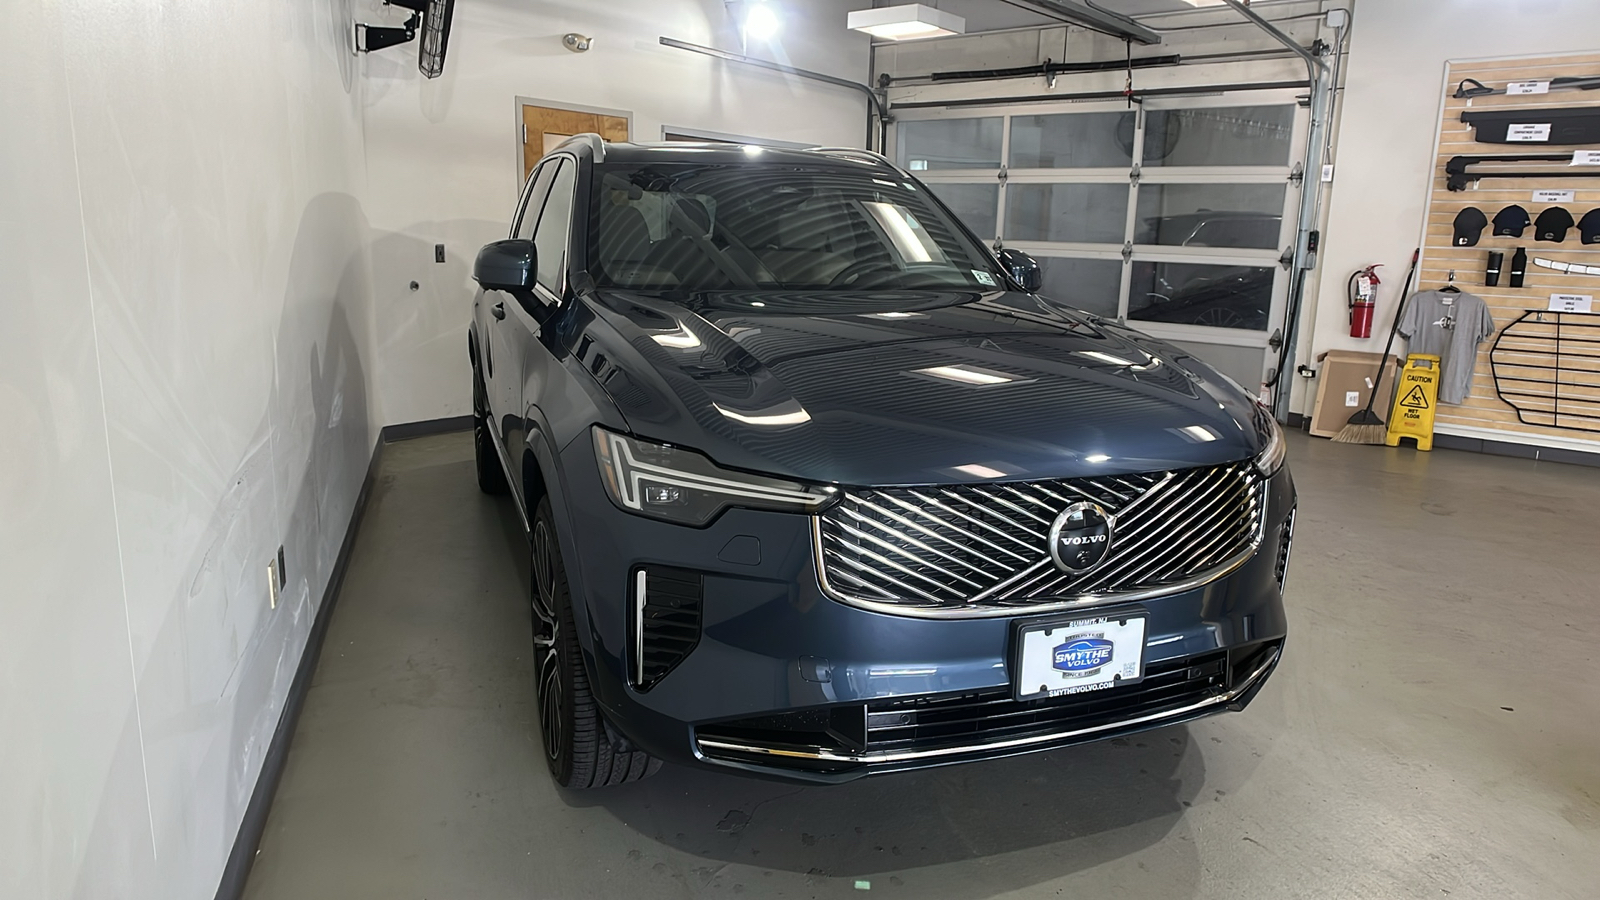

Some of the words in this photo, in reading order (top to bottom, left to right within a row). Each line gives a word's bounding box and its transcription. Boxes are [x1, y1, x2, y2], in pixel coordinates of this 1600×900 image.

[1407, 375, 1432, 383] CAUTION
[1060, 534, 1107, 546] VOLVO
[1055, 649, 1109, 663] SMYTHE
[1068, 658, 1100, 667] VOLVO
[1049, 681, 1115, 698] SMYTHEVOLVO.COM
